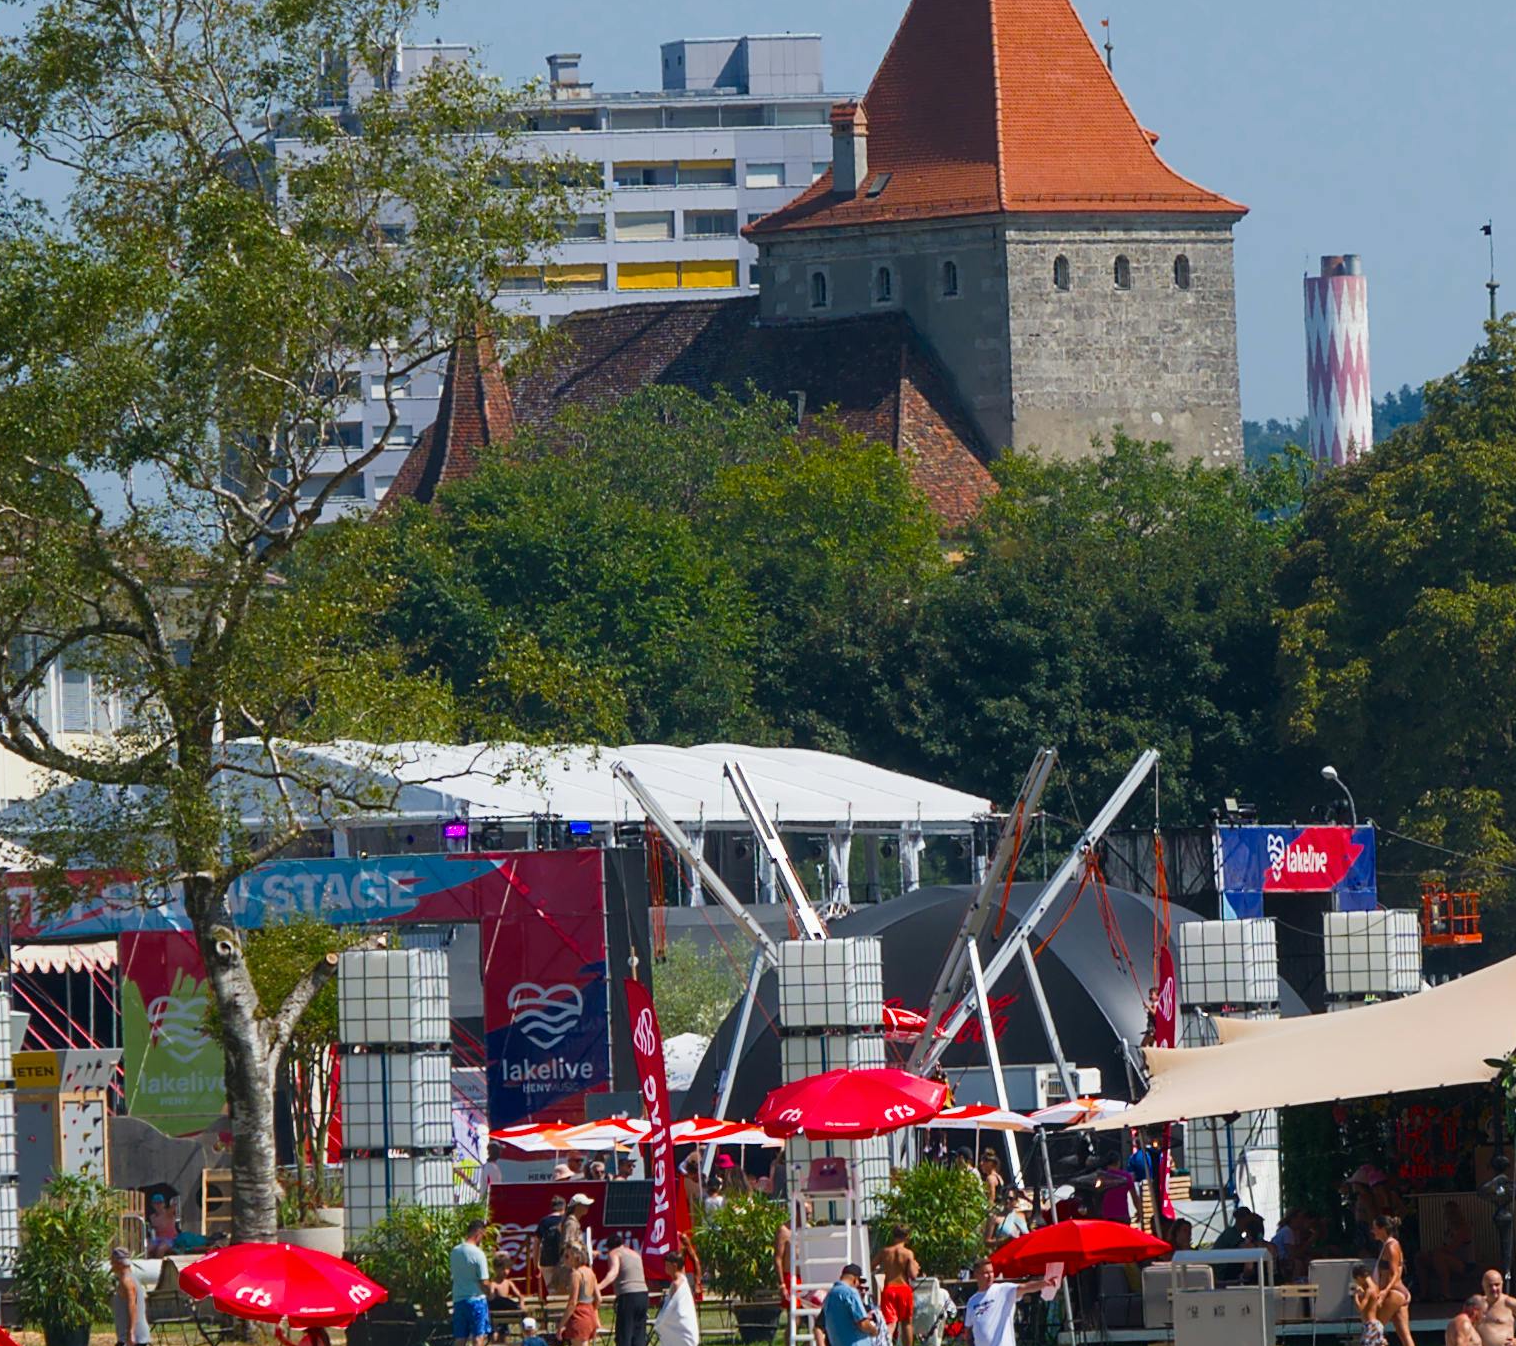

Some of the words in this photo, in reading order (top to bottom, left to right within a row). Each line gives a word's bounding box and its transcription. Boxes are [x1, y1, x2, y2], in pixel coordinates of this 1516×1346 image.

[1286, 843, 1328, 873] lakelive
[263, 870, 418, 913] STAGE
[502, 1056, 594, 1082] lakelive
[884, 1104, 915, 1122] rts
[235, 1286, 272, 1307] rts
